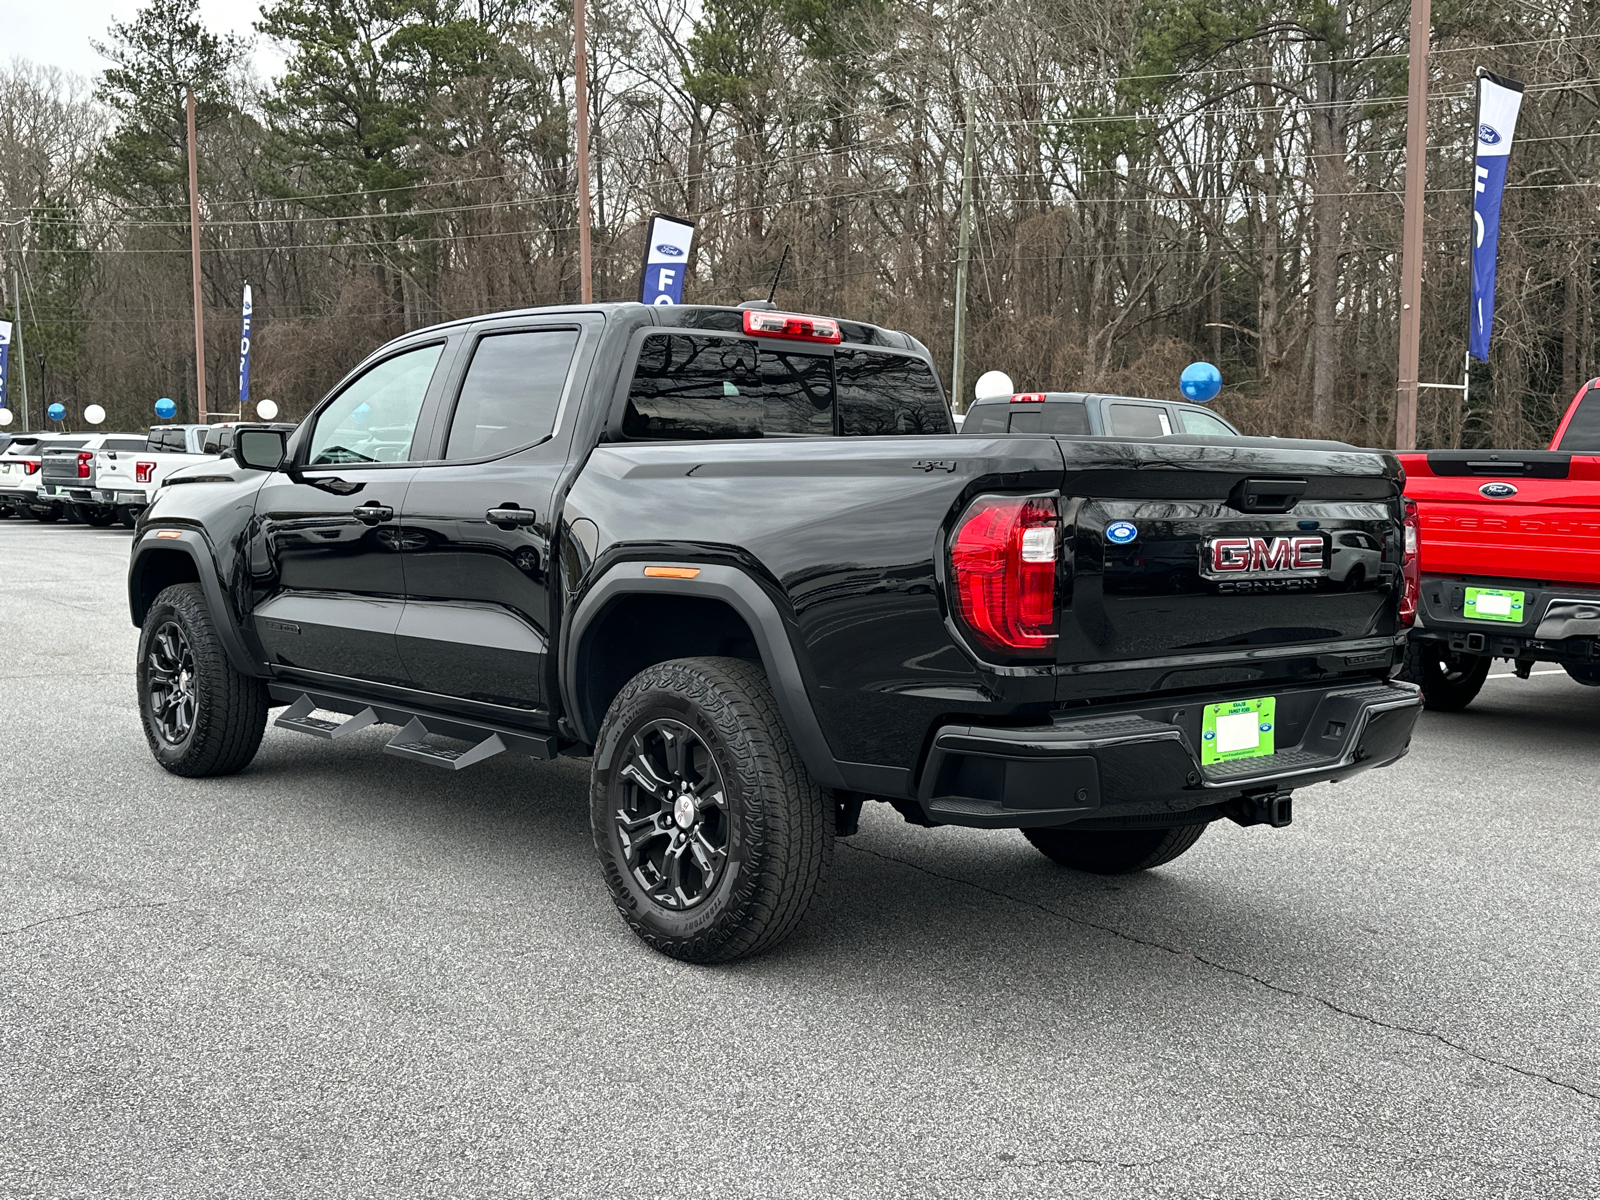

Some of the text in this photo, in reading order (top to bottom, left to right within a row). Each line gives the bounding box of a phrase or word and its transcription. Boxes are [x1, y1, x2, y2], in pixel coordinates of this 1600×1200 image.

[1478, 125, 1495, 142] Ford
[660, 245, 679, 256] Ford
[1487, 485, 1508, 495] Ford
[1211, 536, 1324, 573] GMC
[1217, 578, 1318, 594] CANYON
[695, 713, 742, 848] WRANGLER
[683, 896, 722, 931] TERRITORY
